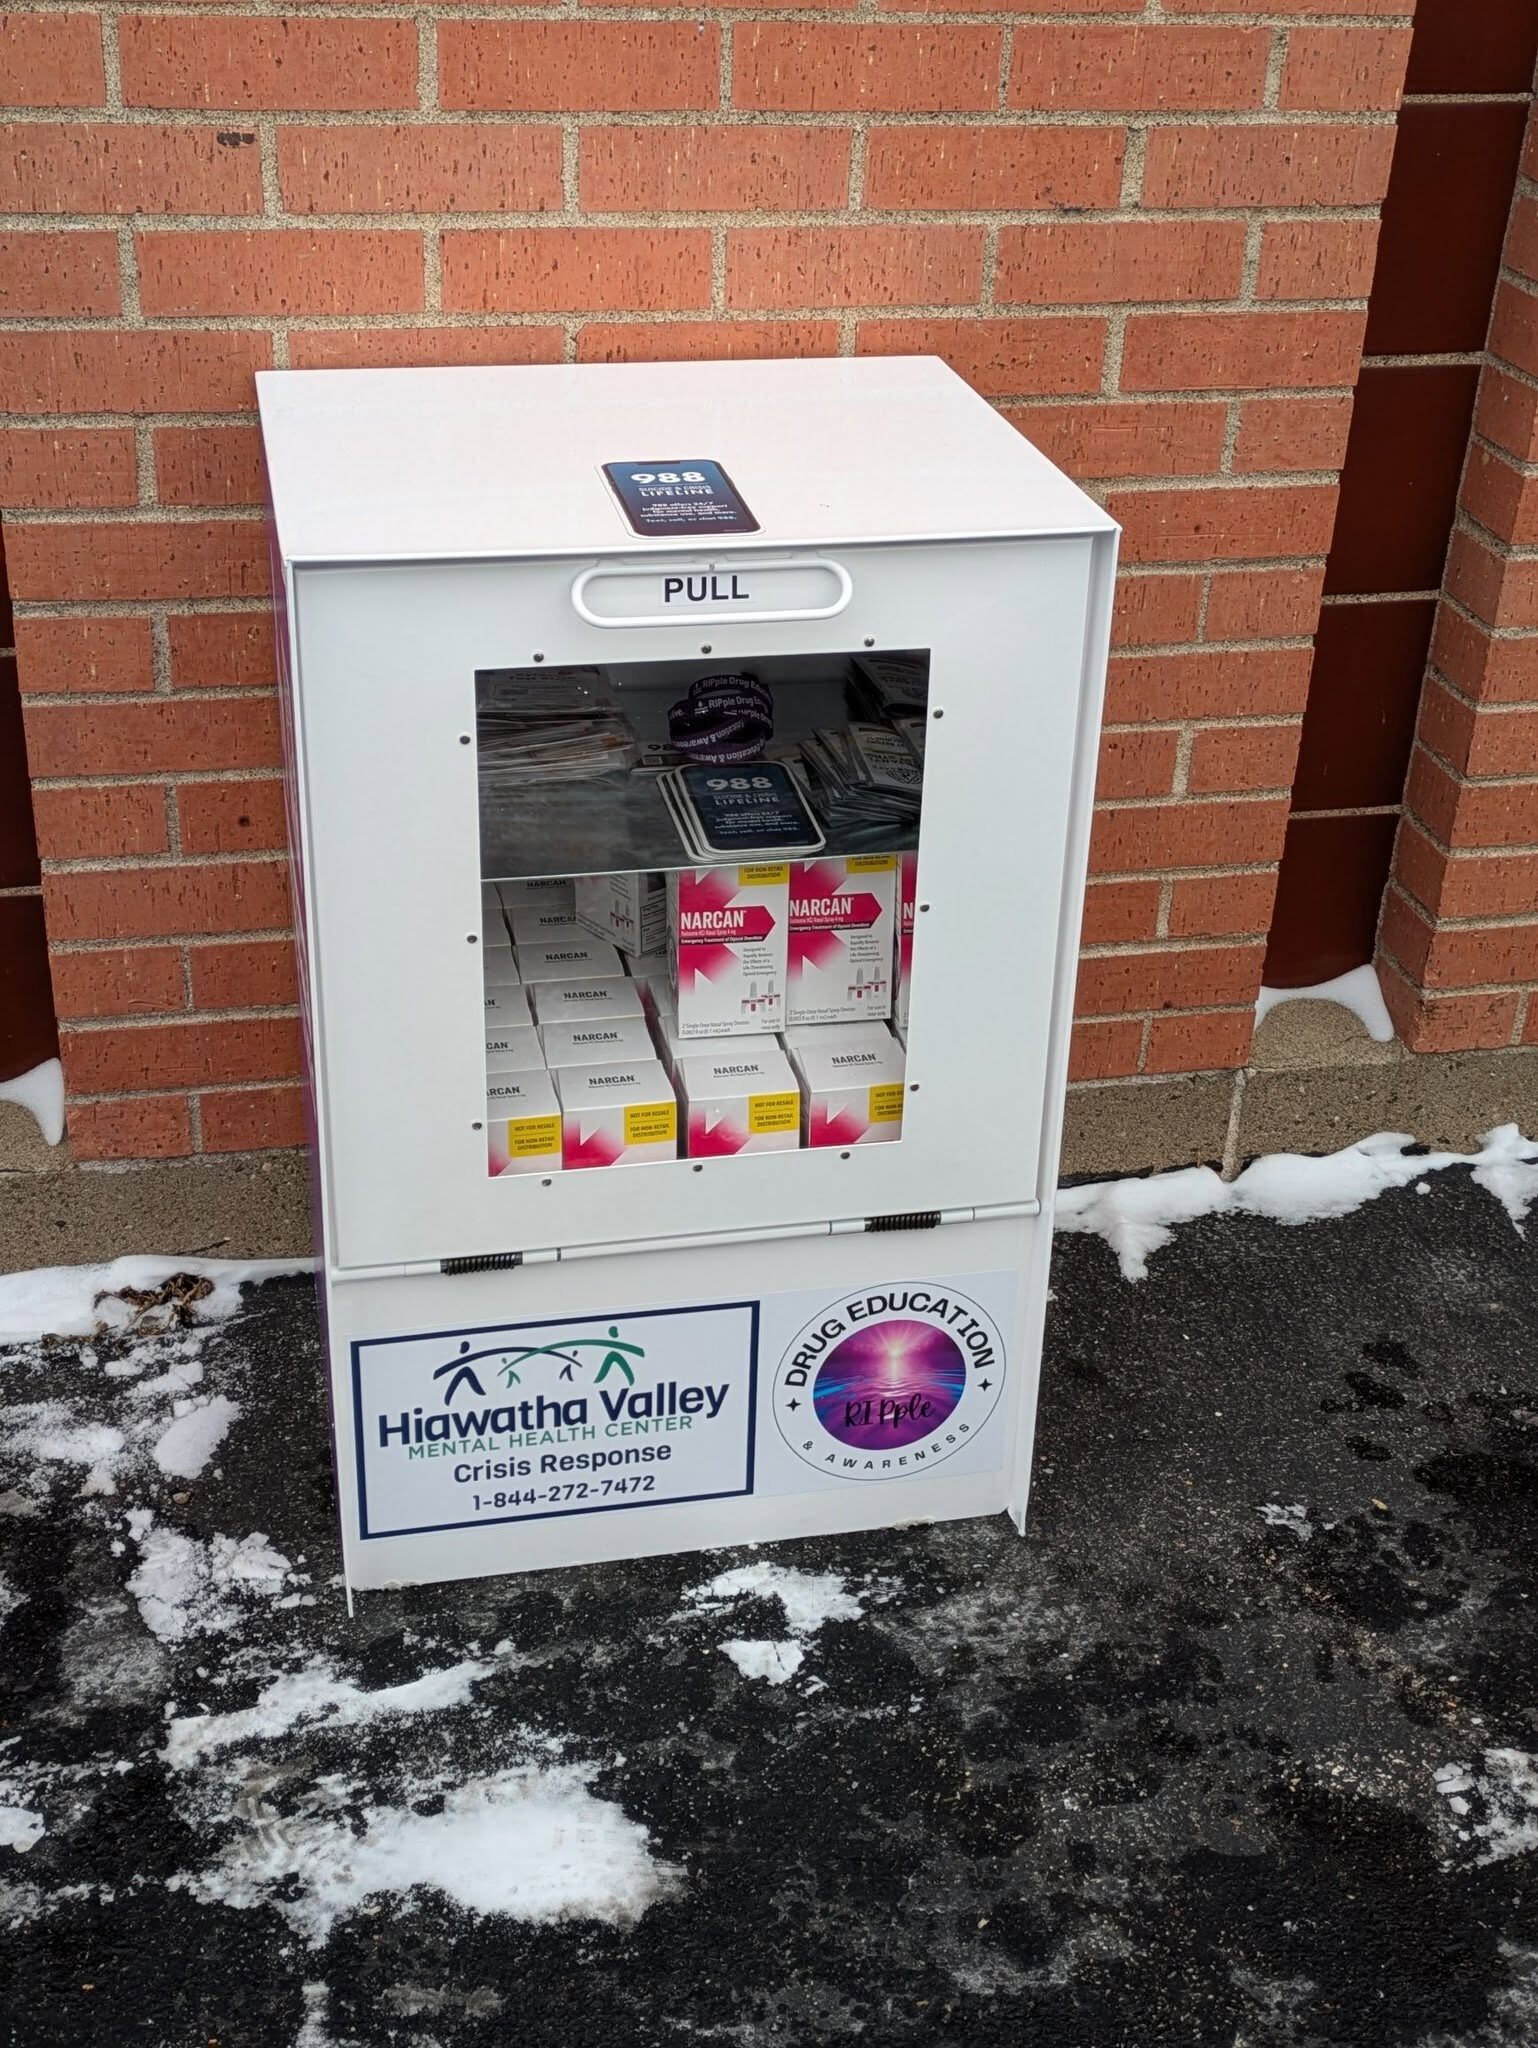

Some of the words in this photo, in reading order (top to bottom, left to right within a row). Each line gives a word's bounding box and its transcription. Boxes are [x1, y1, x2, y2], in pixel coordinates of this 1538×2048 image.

[631, 472, 705, 483] 988
[664, 576, 749, 602] PULL
[706, 777, 772, 790] 988
[715, 797, 780, 805] LIFELINE
[790, 898, 851, 916] NARCAN
[681, 910, 744, 929] NARCAN
[546, 952, 587, 960] NARCAN
[564, 991, 607, 999] NARCAN
[573, 1032, 618, 1041] NARCAN
[832, 1054, 876, 1064] NARCAN
[713, 1065, 759, 1074] NARCAN
[589, 1075, 635, 1085] NARCAN
[784, 1318, 846, 1387] DRUG
[846, 1292, 996, 1370] EDUCATION
[379, 1395, 587, 1448] Hiawatha
[599, 1381, 730, 1421] Valley
[408, 1437, 500, 1460] MENTAL
[509, 1426, 596, 1448] HEALTH
[604, 1416, 693, 1437] CENTER
[802, 1440, 814, 1450] &
[824, 1424, 970, 1469] AWARENESS
[454, 1456, 531, 1483] Crisis
[540, 1444, 672, 1474] Response
[473, 1475, 655, 1510] 1-844-272-7472
